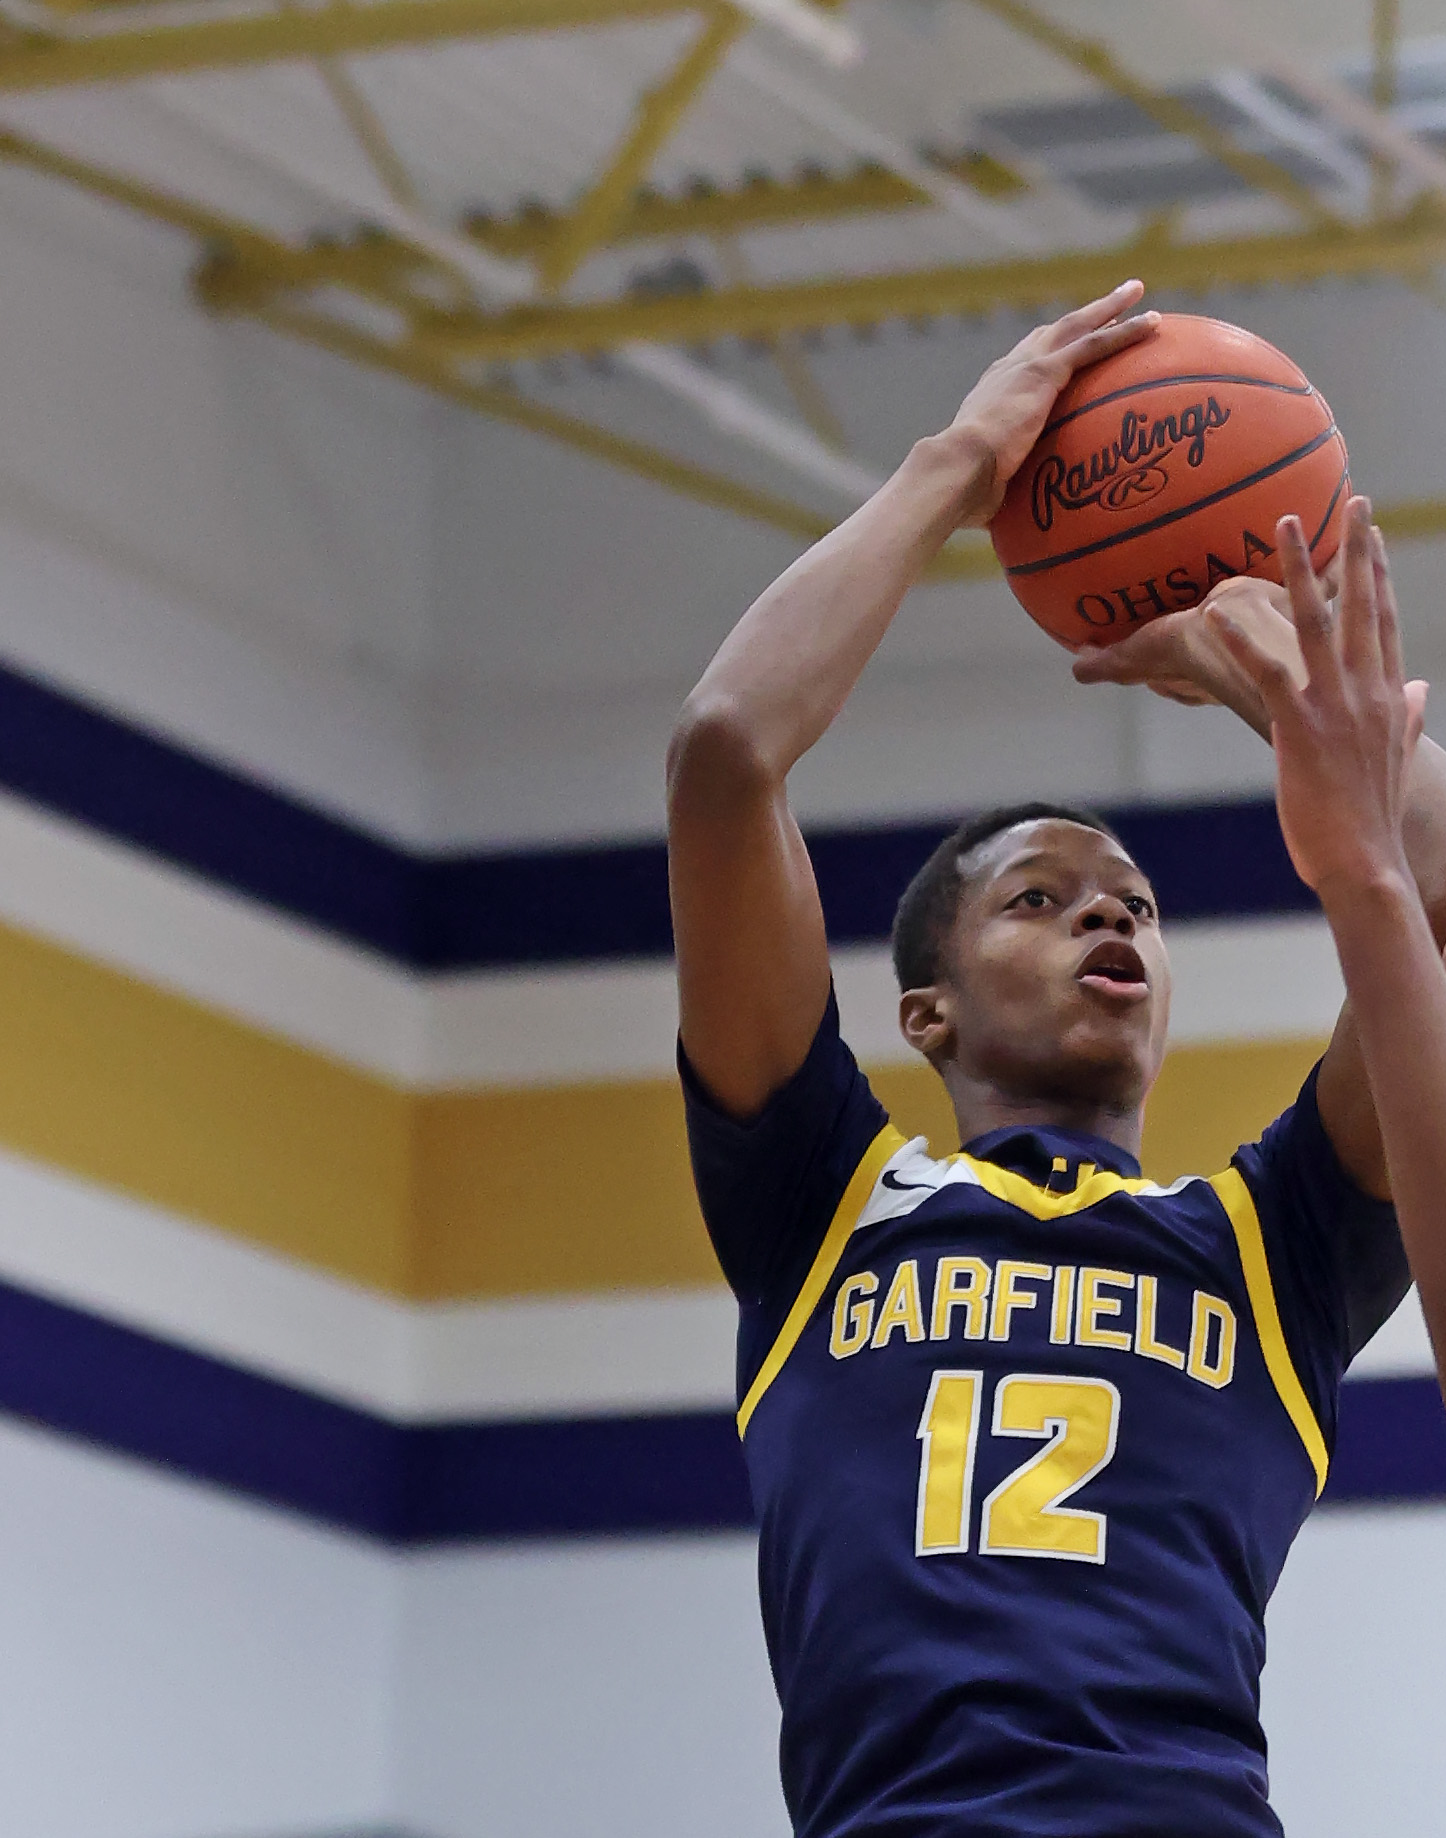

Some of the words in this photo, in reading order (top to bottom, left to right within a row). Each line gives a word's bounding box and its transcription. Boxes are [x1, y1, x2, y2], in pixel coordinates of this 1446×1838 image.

[1031, 397, 1231, 532] Rawlings
[1076, 529, 1278, 627] OHSAA
[828, 1256, 1237, 1389] GARFIELD
[915, 1369, 1121, 1565] 12
